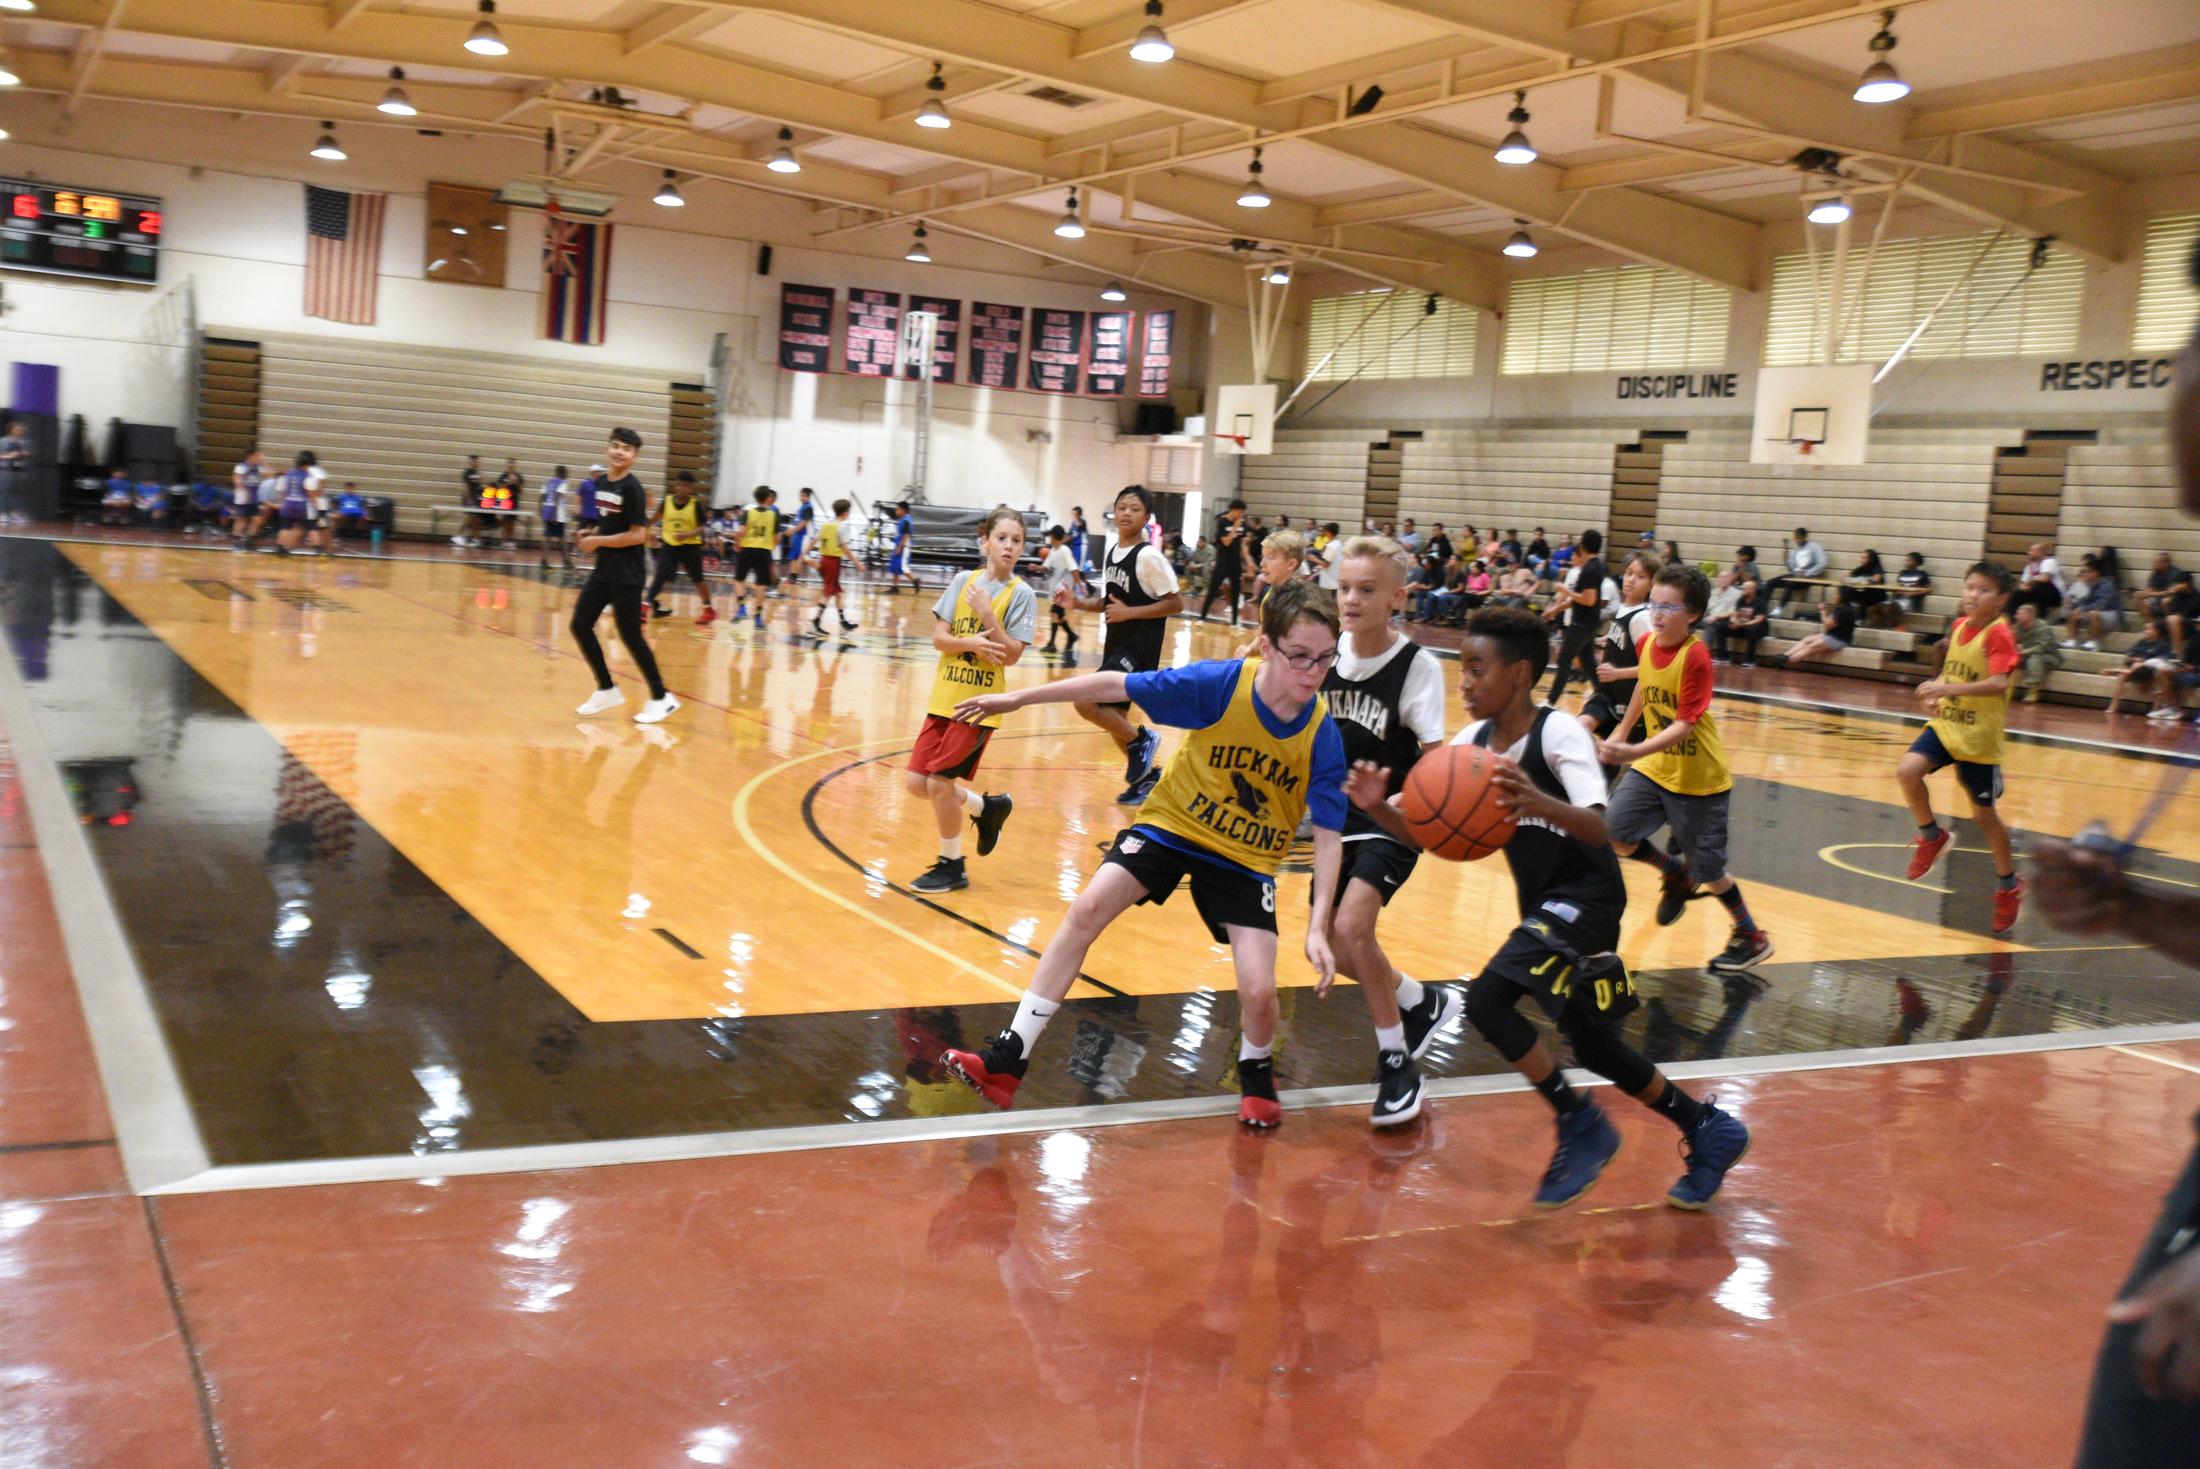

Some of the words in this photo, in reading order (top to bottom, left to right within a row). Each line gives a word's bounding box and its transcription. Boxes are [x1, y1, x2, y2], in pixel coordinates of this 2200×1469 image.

[1617, 374, 1738, 399] DISCIPLINE
[2040, 359, 2171, 391] RESPEC
[1208, 745, 1299, 794] HICKAM
[1186, 791, 1290, 852] FALCONS
[1261, 882, 1274, 912] 8
